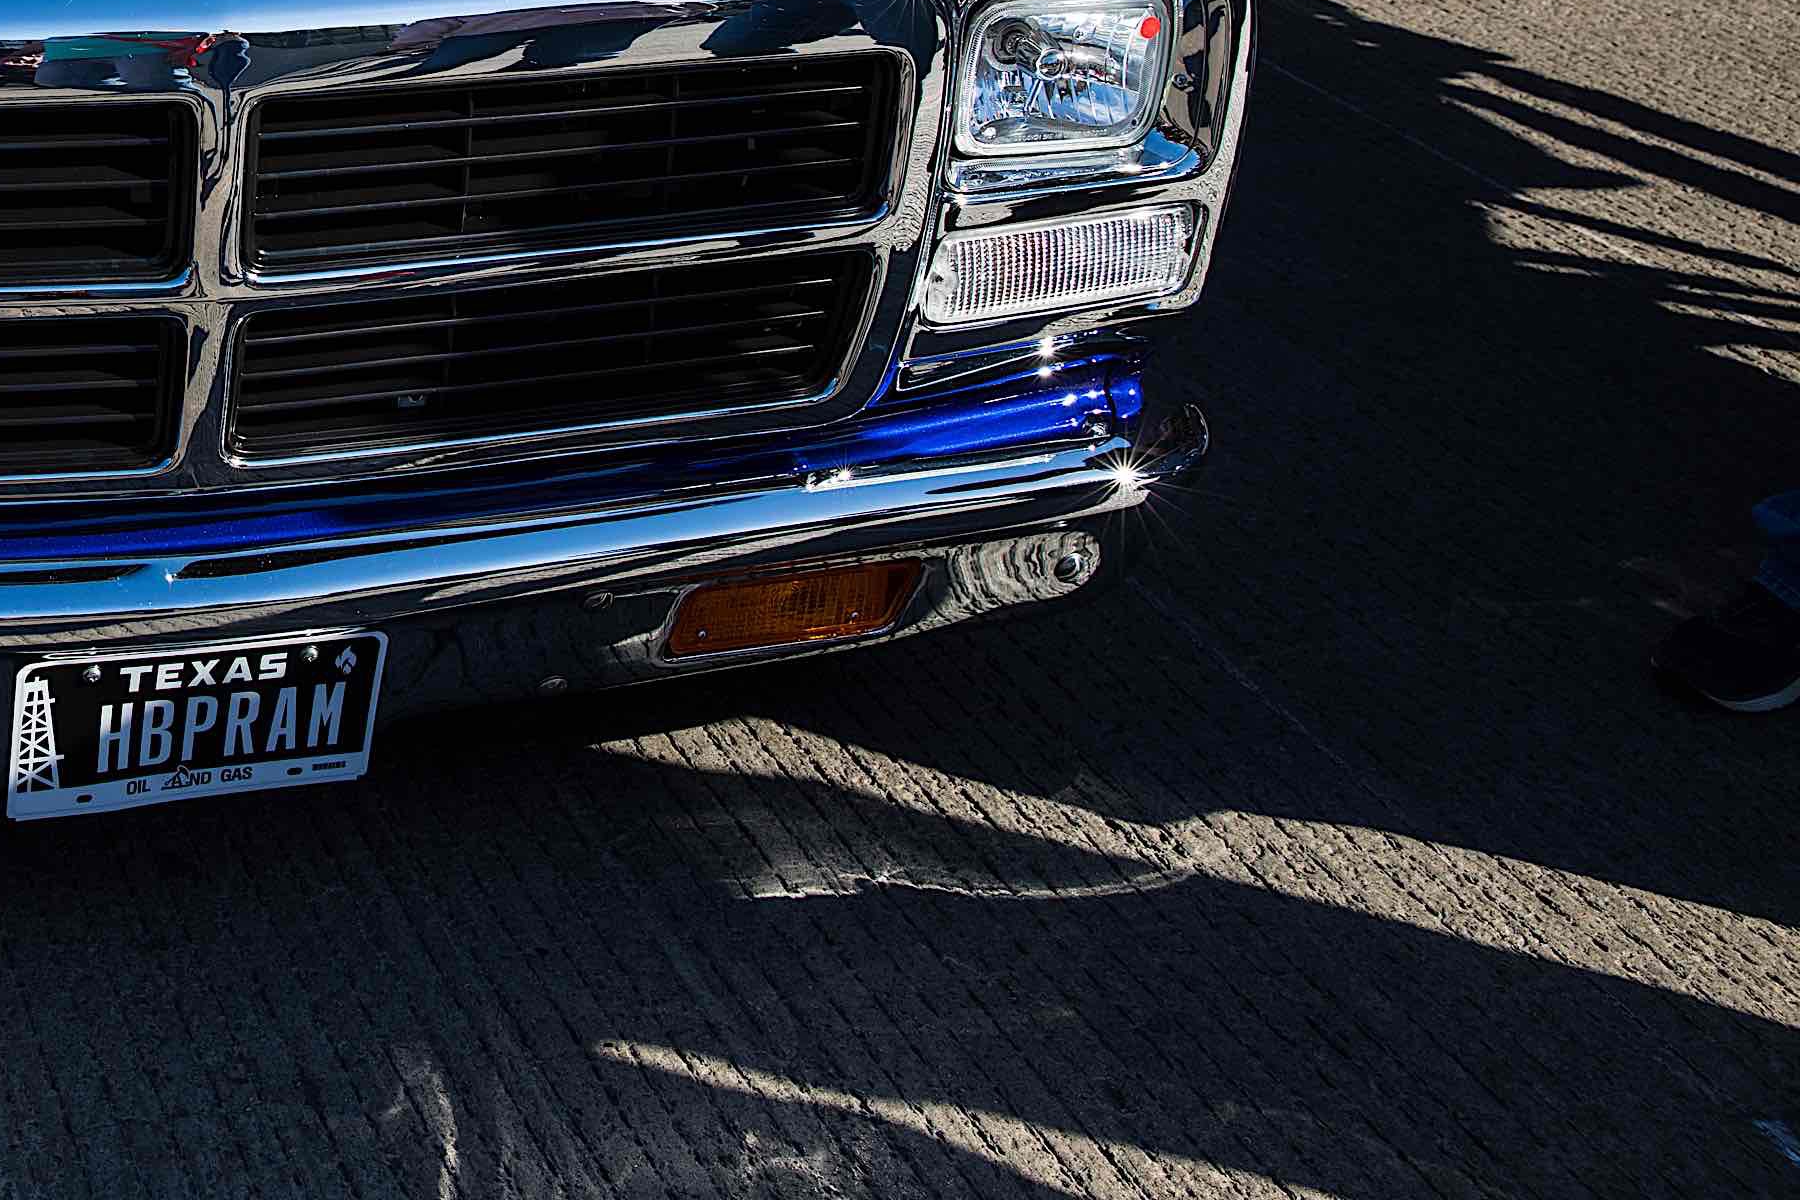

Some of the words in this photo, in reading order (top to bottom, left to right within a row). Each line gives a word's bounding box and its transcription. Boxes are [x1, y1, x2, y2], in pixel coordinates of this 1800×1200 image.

[119, 652, 289, 693] TEXAS
[96, 680, 348, 774] HBPRAM
[126, 780, 151, 796] OIL
[160, 765, 212, 791] AND
[220, 766, 254, 784] GAS
